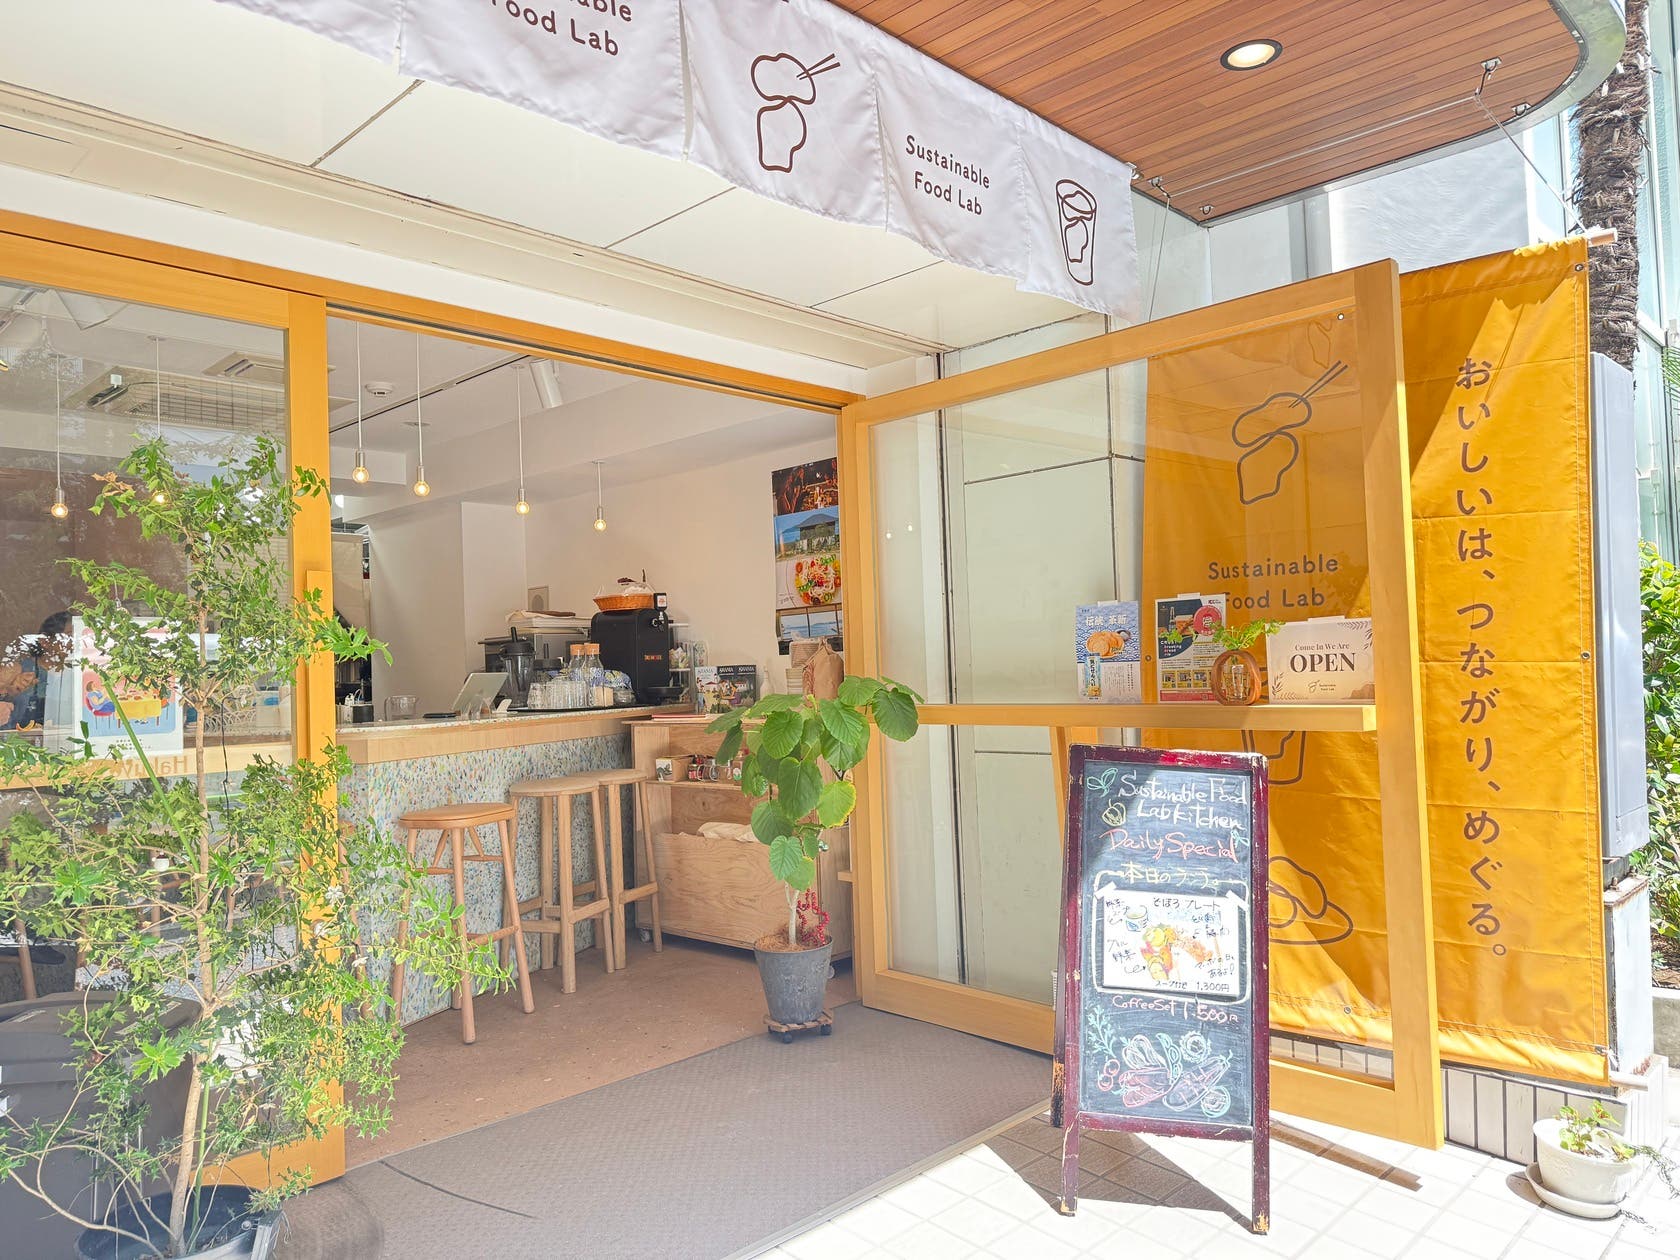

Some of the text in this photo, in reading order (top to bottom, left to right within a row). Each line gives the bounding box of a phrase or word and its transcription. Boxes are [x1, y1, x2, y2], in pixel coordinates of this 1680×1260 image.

[491, 0, 619, 56] ood Lab
[905, 134, 990, 189] Sustainable
[914, 170, 982, 215] Food Lab
[1208, 553, 1339, 580] Sustainable
[1282, 587, 1326, 608] Lab
[1290, 652, 1356, 673] OPEN
[1295, 643, 1315, 651] Come
[1337, 642, 1349, 650] Are
[1455, 357, 1507, 957] おいしいは、つながり、めぐる。
[1118, 769, 1248, 805] Sustainable Food
[1136, 799, 1172, 820] Lab
[1099, 828, 1239, 864] Daily Special
